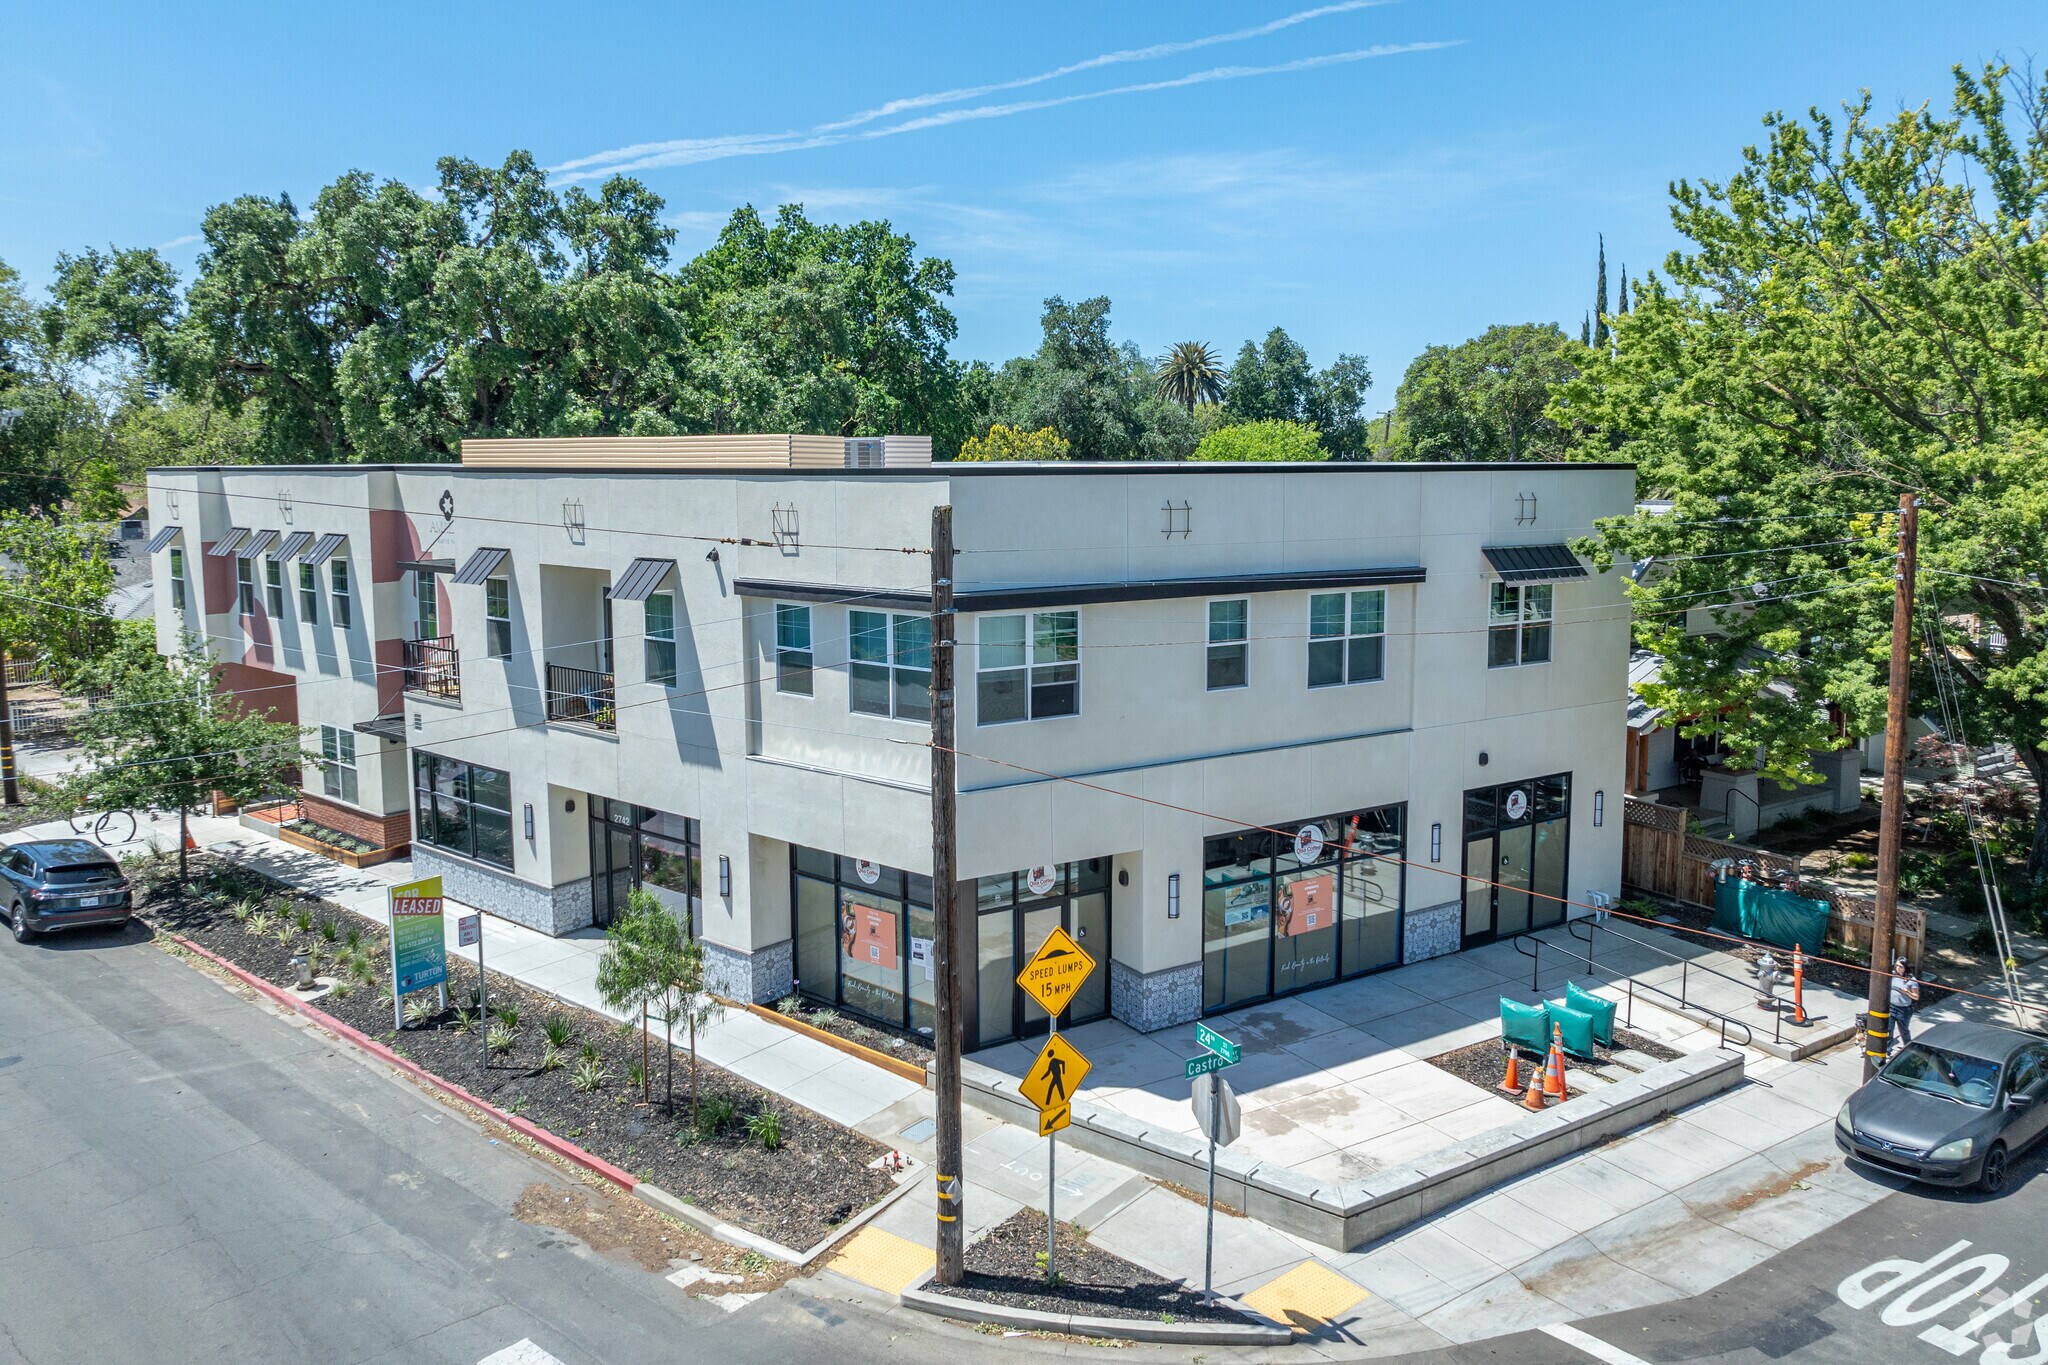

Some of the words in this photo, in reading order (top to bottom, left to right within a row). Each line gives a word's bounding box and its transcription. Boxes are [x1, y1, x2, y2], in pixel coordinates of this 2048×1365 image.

[613, 813, 630, 826] 2742
[1040, 877, 1054, 885] Coffee
[394, 899, 441, 914] LEASED
[460, 923, 477, 931] PARKING
[414, 965, 443, 981] TURTON
[1029, 966, 1054, 981] SPEED
[1057, 960, 1083, 975] LUMPS
[1041, 982, 1053, 998] 15
[1054, 982, 1071, 995] MPH
[1188, 1057, 1223, 1075] Castro
